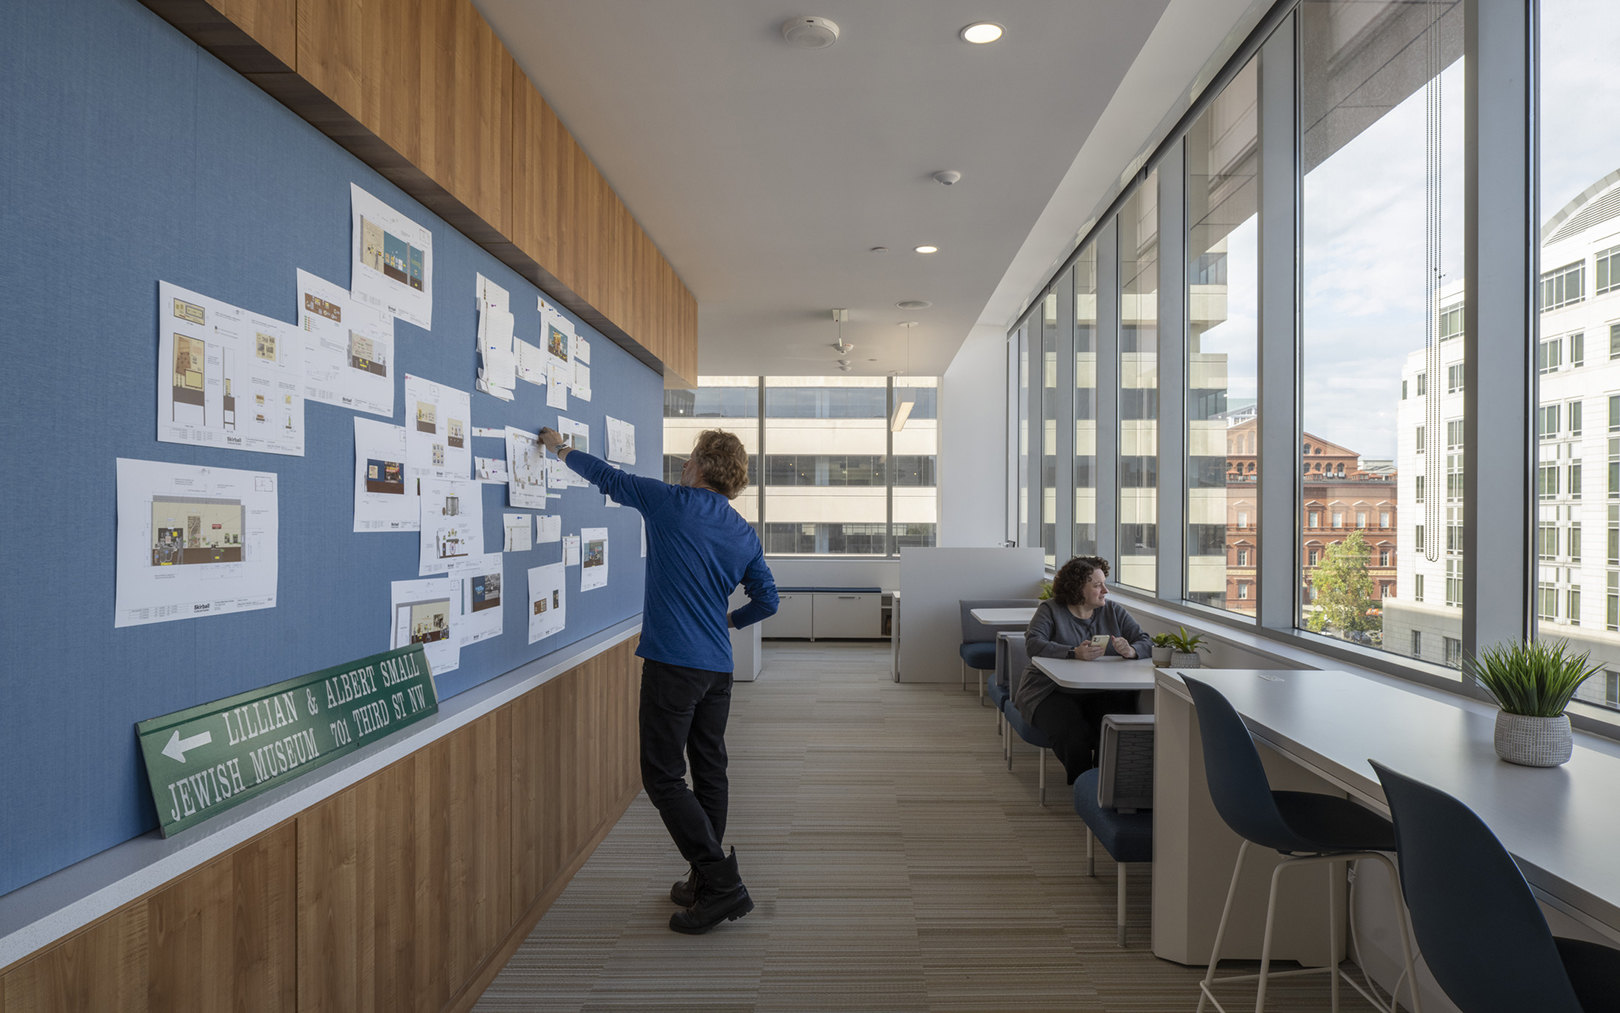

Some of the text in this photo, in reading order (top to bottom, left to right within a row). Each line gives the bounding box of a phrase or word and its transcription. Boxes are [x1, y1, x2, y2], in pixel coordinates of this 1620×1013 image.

[168, 684, 426, 822] JEWISH MUSEUM 701 THIRD ST NW
[222, 653, 420, 746] LILLIAN & ALBERT SMALL
